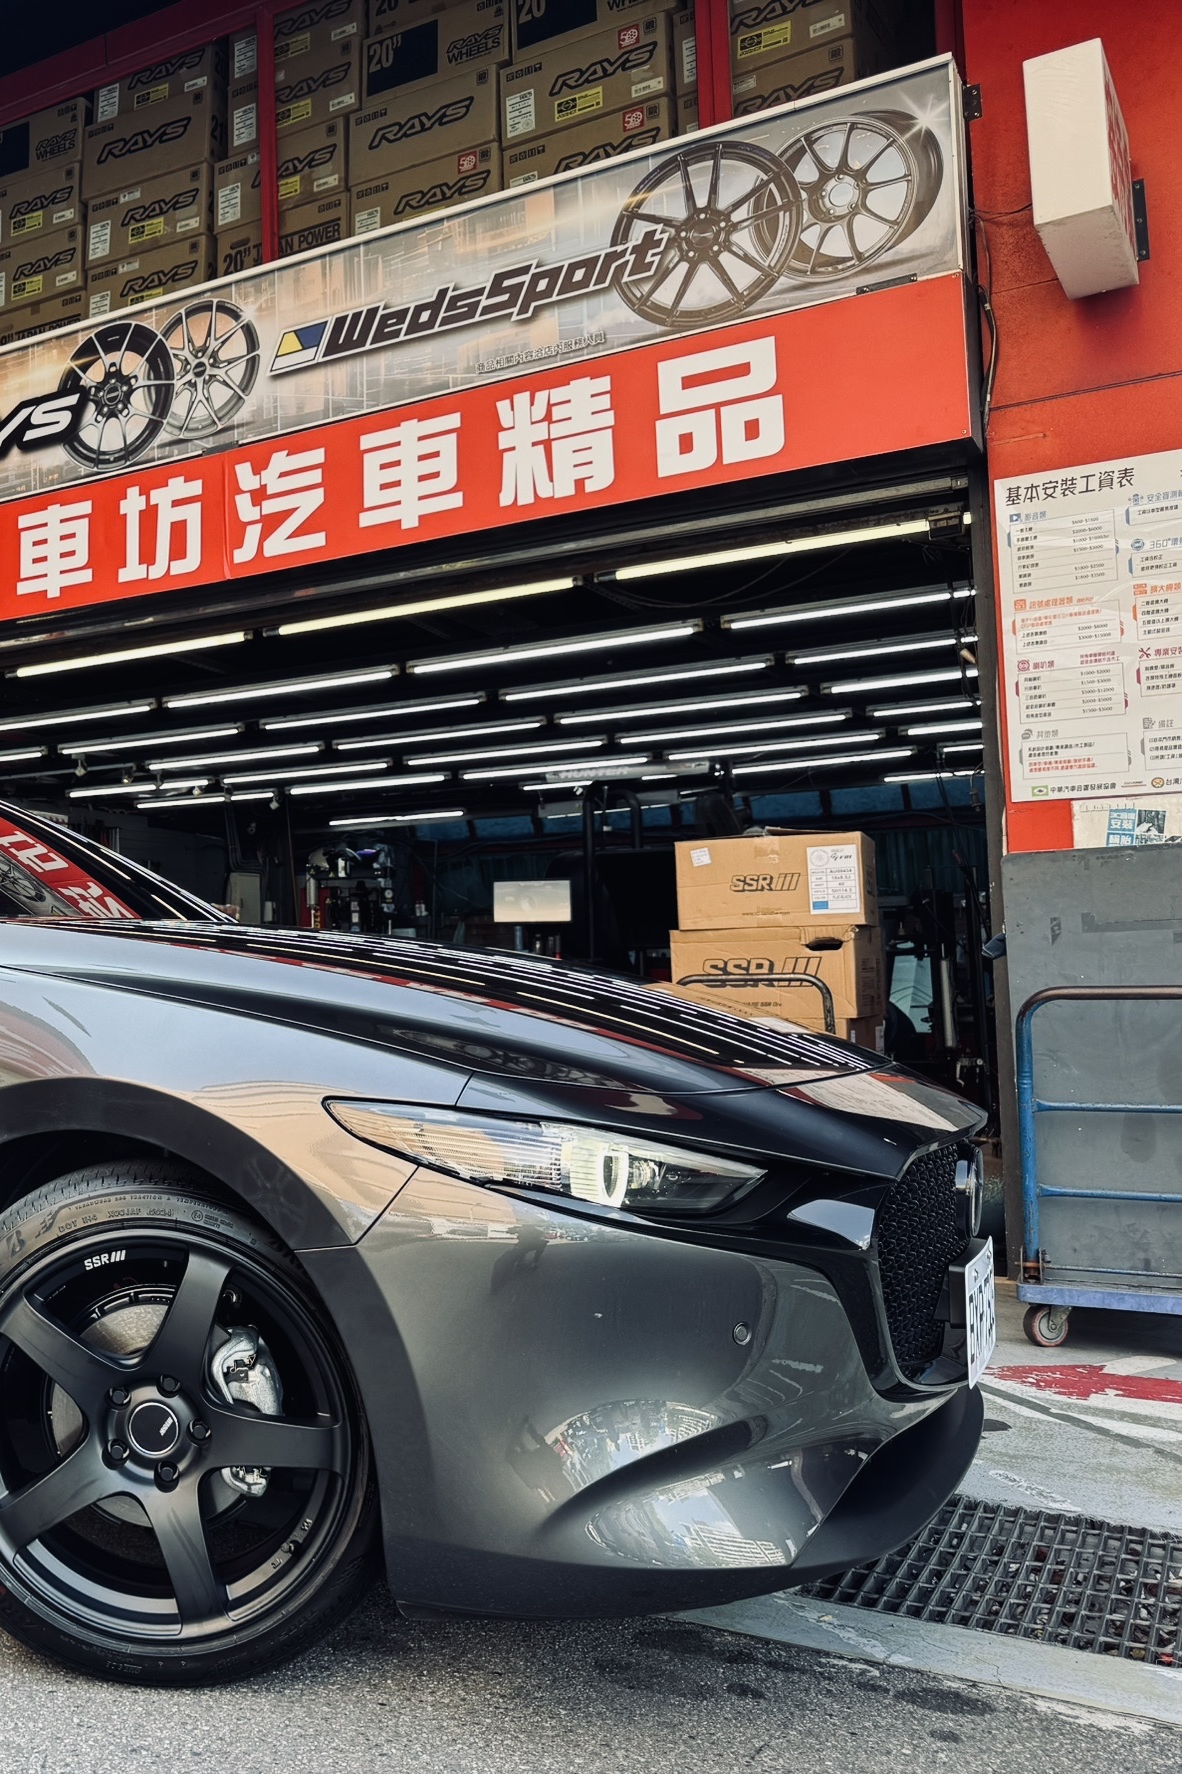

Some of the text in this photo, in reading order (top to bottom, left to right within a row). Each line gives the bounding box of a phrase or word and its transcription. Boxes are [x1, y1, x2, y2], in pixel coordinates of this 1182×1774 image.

[446, 24, 504, 54] RAYS
[447, 37, 501, 65] WHEELS
[128, 48, 206, 91] RAYS
[549, 41, 658, 97] RAYS
[734, 66, 845, 118] RAYS
[35, 128, 78, 152] RAYS
[96, 117, 192, 165] RAYS
[368, 95, 475, 151] RAYS
[35, 138, 76, 161] WHEELS
[9, 185, 74, 220] RAYS
[120, 188, 200, 228] RAYS
[393, 169, 491, 216] RAYS
[298, 221, 342, 249] POWER
[12, 247, 77, 282] RAYS
[120, 260, 198, 299] RAYS
[321, 225, 670, 360] WedsSport
[1005, 467, 1135, 507] 基本安裝工資表
[730, 874, 774, 893] SSR
[84, 1252, 111, 1272] SSR
